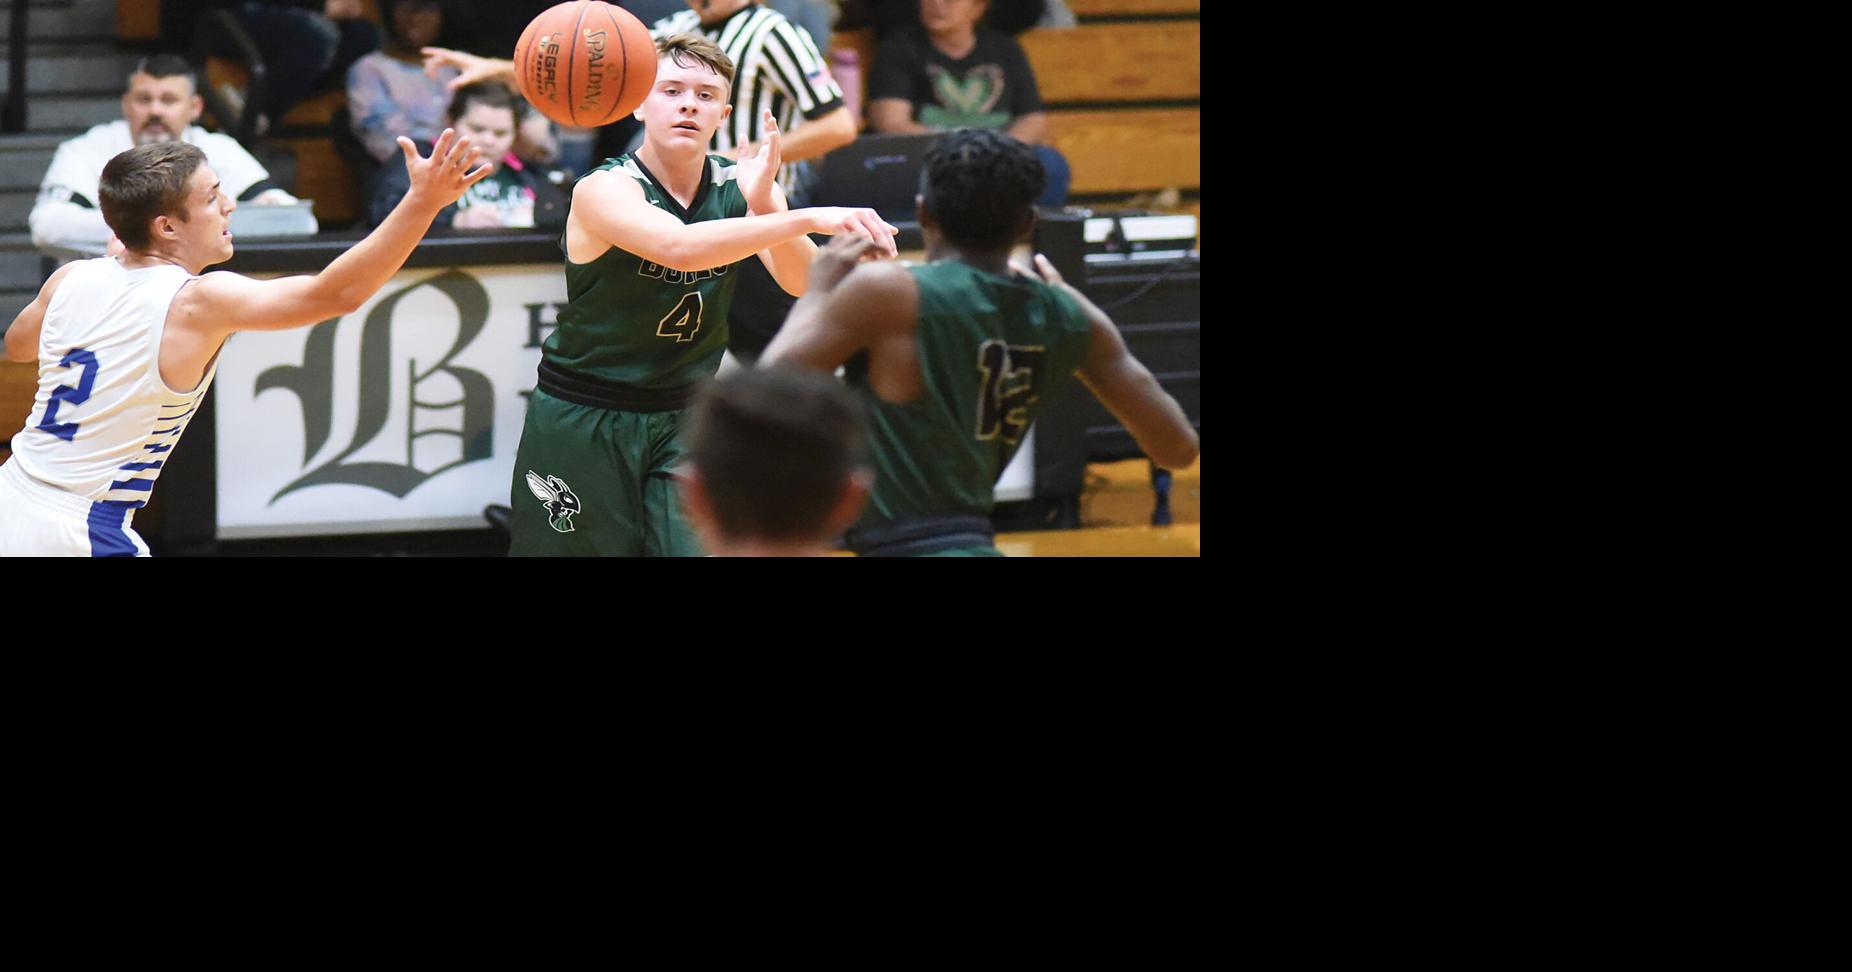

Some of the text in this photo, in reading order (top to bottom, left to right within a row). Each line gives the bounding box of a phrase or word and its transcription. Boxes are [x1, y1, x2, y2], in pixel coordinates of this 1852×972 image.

[543, 31, 563, 104] LEGACY
[579, 28, 607, 111] SPALDING
[655, 290, 704, 343] 4
[34, 348, 99, 442] 2
